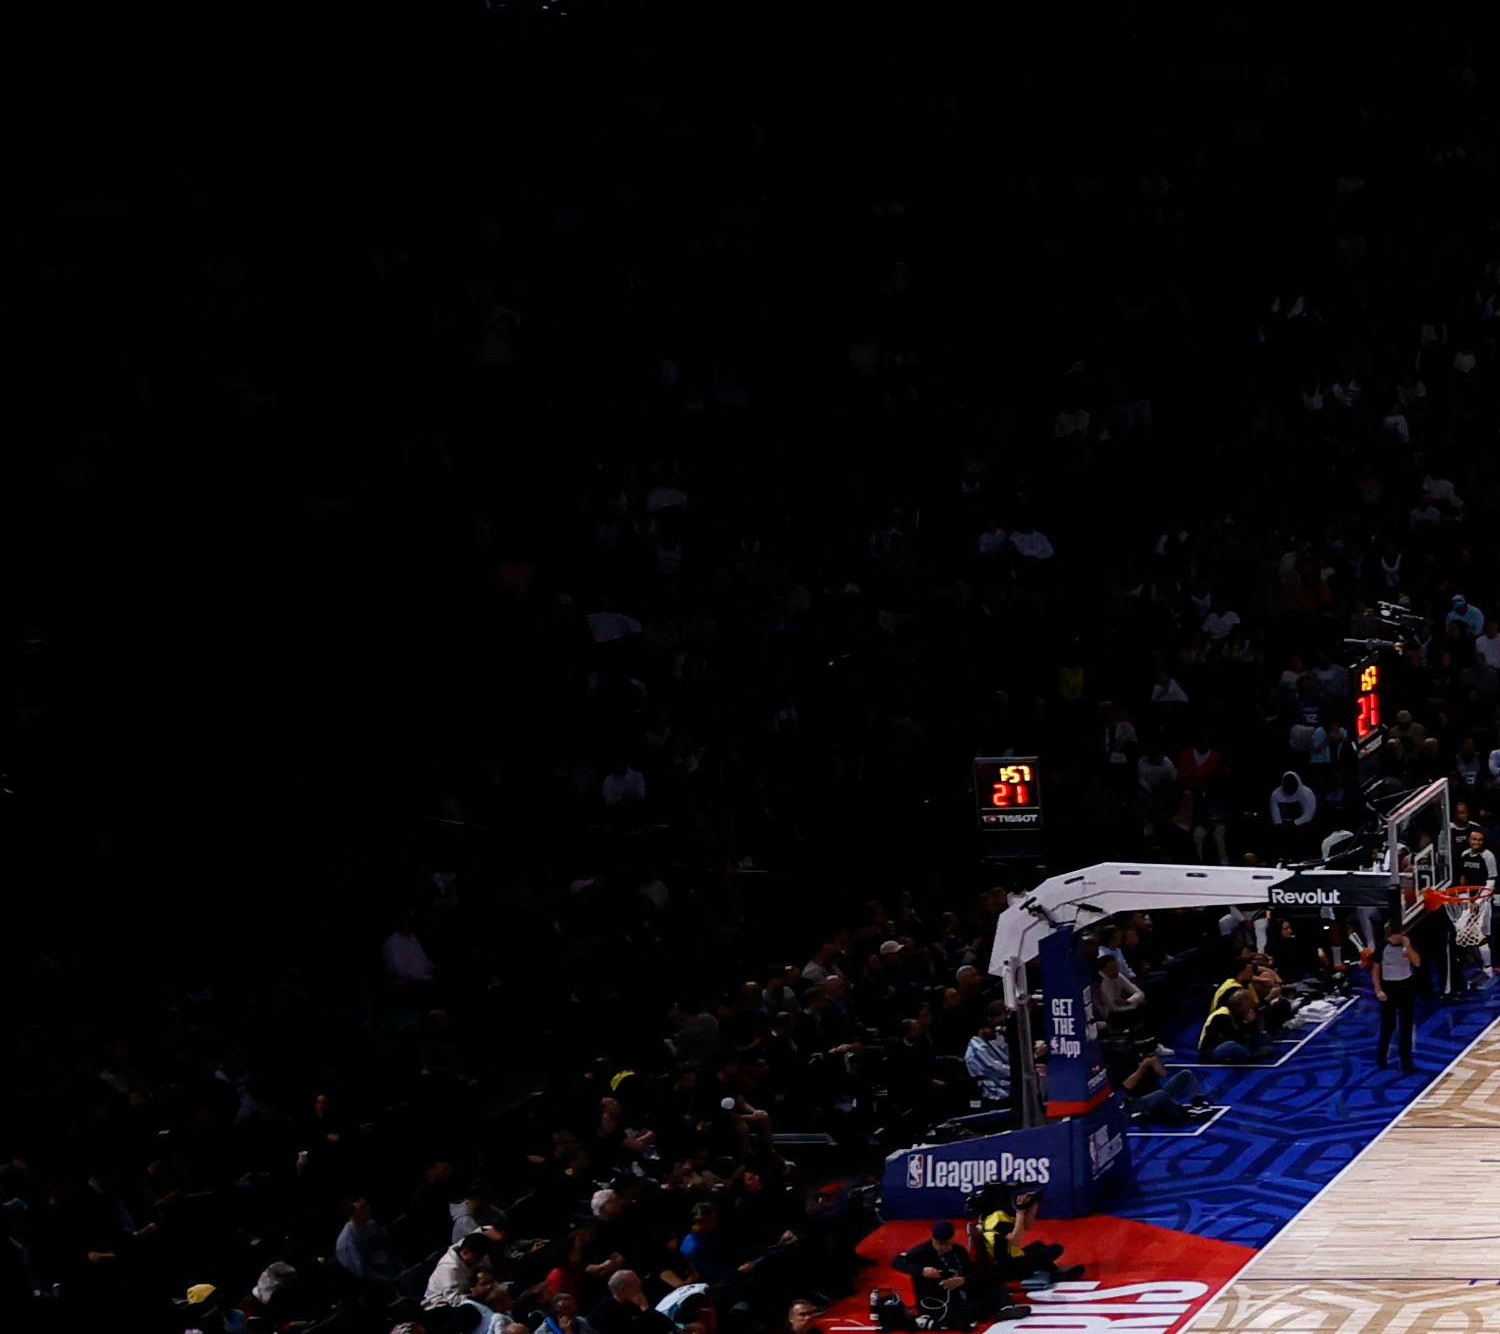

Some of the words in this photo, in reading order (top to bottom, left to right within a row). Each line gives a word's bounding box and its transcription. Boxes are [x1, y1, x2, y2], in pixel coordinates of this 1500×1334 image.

[1357, 693, 1379, 738] 21
[993, 783, 1028, 806] 21
[1271, 886, 1341, 906] Revolut
[1052, 998, 1073, 1016] GET
[1052, 1017, 1075, 1036] THE
[1059, 1037, 1081, 1058] App
[926, 1155, 997, 1192] League
[1000, 1152, 1049, 1184] Pass
